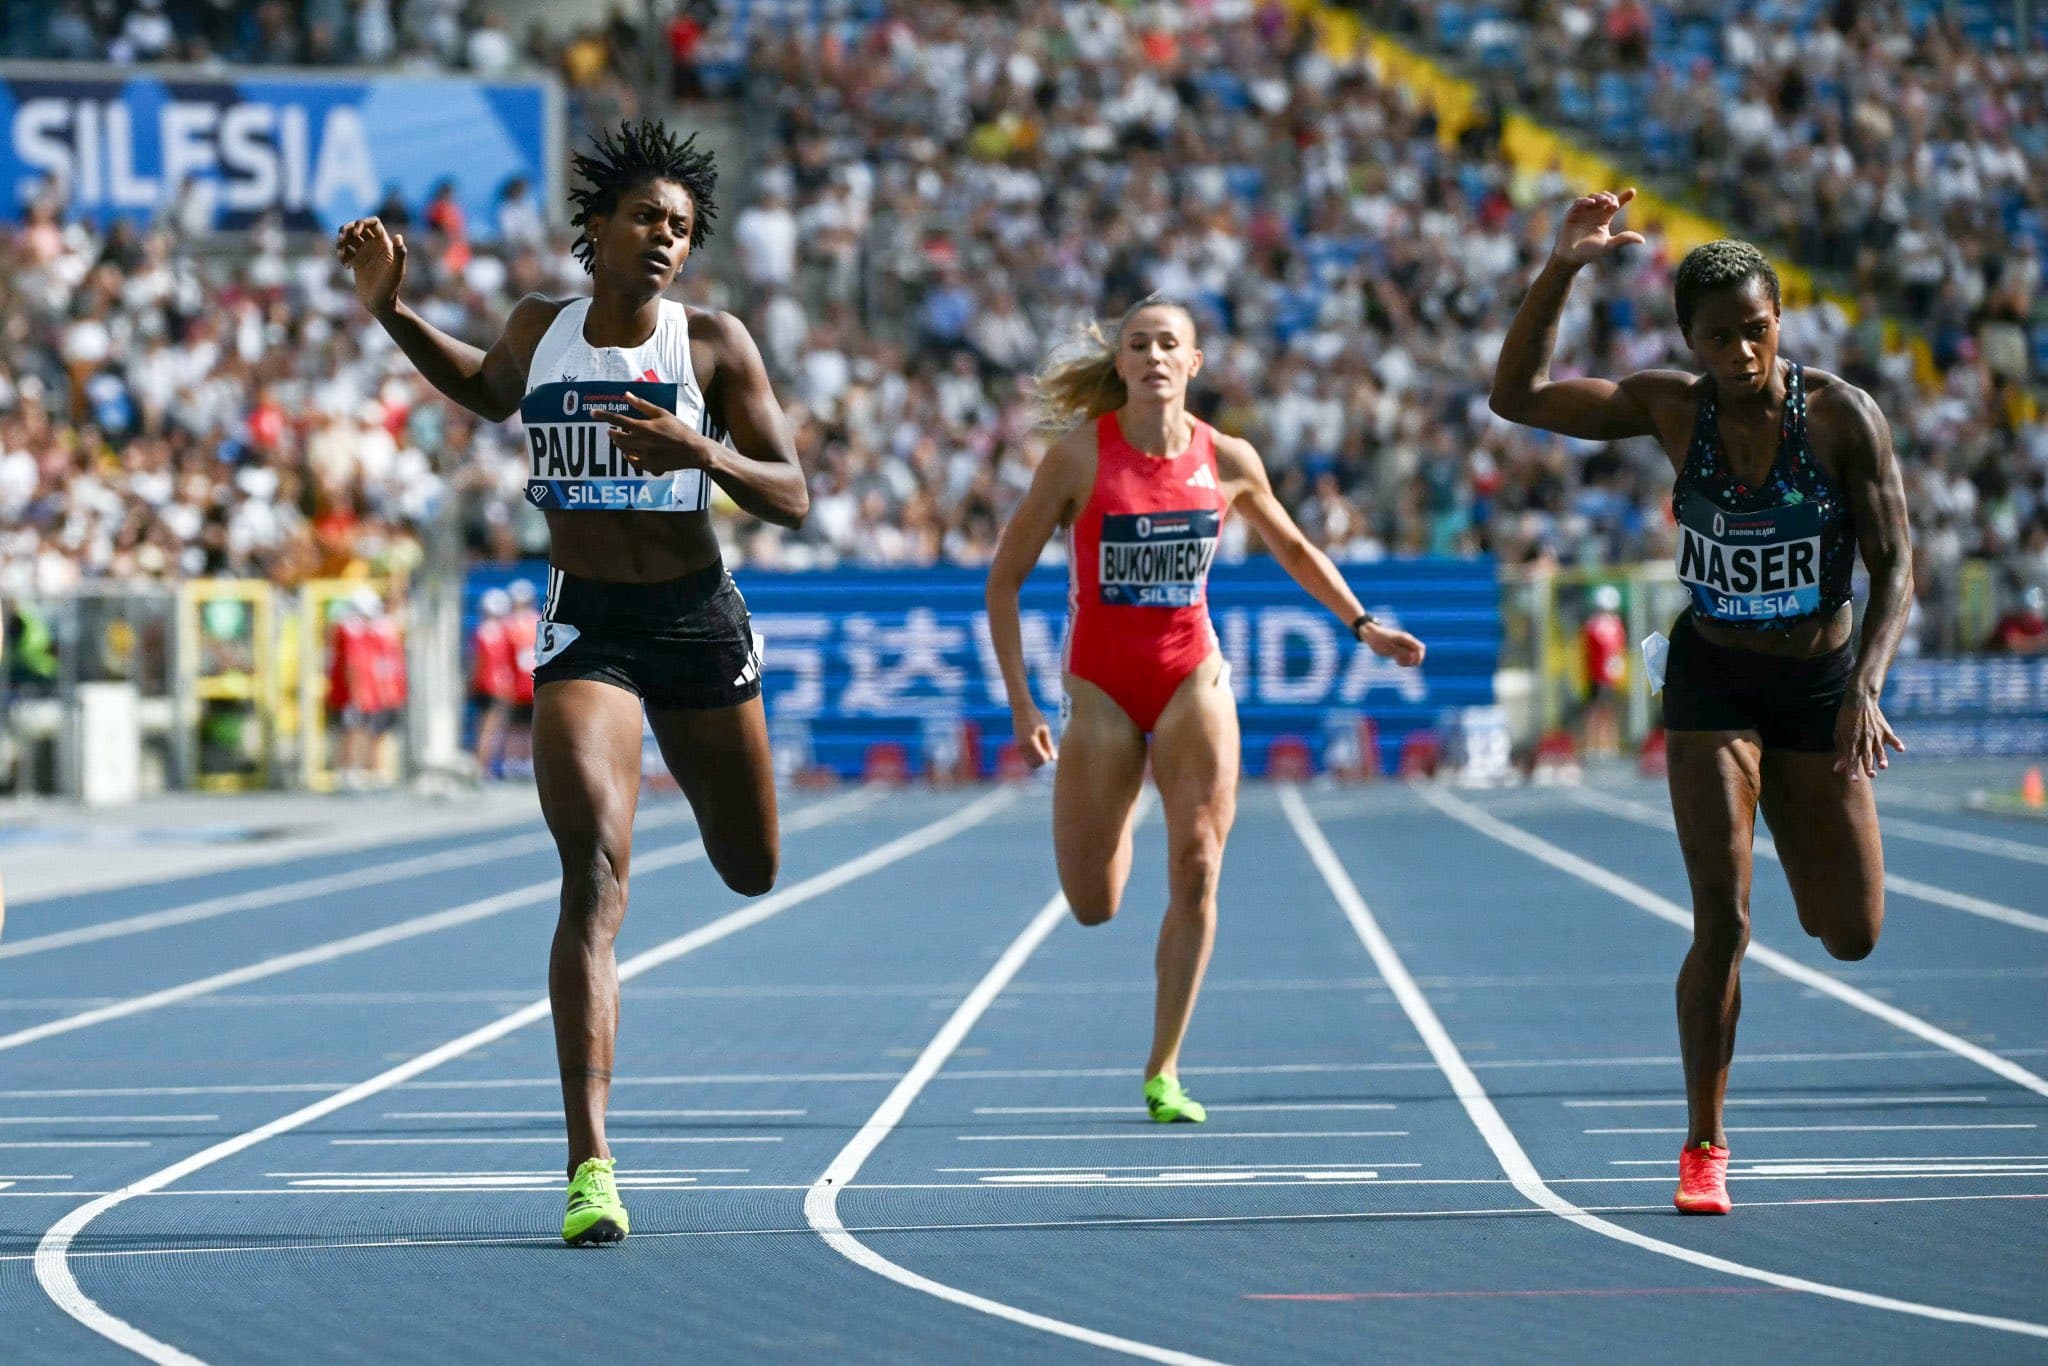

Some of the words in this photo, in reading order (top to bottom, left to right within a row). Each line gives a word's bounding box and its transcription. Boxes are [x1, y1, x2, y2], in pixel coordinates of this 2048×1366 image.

[12, 97, 381, 210] SILESIA
[528, 425, 666, 477] PAULI
[567, 485, 654, 505] SILESIA
[1679, 529, 1816, 594] NASER
[1716, 594, 1800, 616] SILESIA
[973, 605, 1429, 704] WDA
